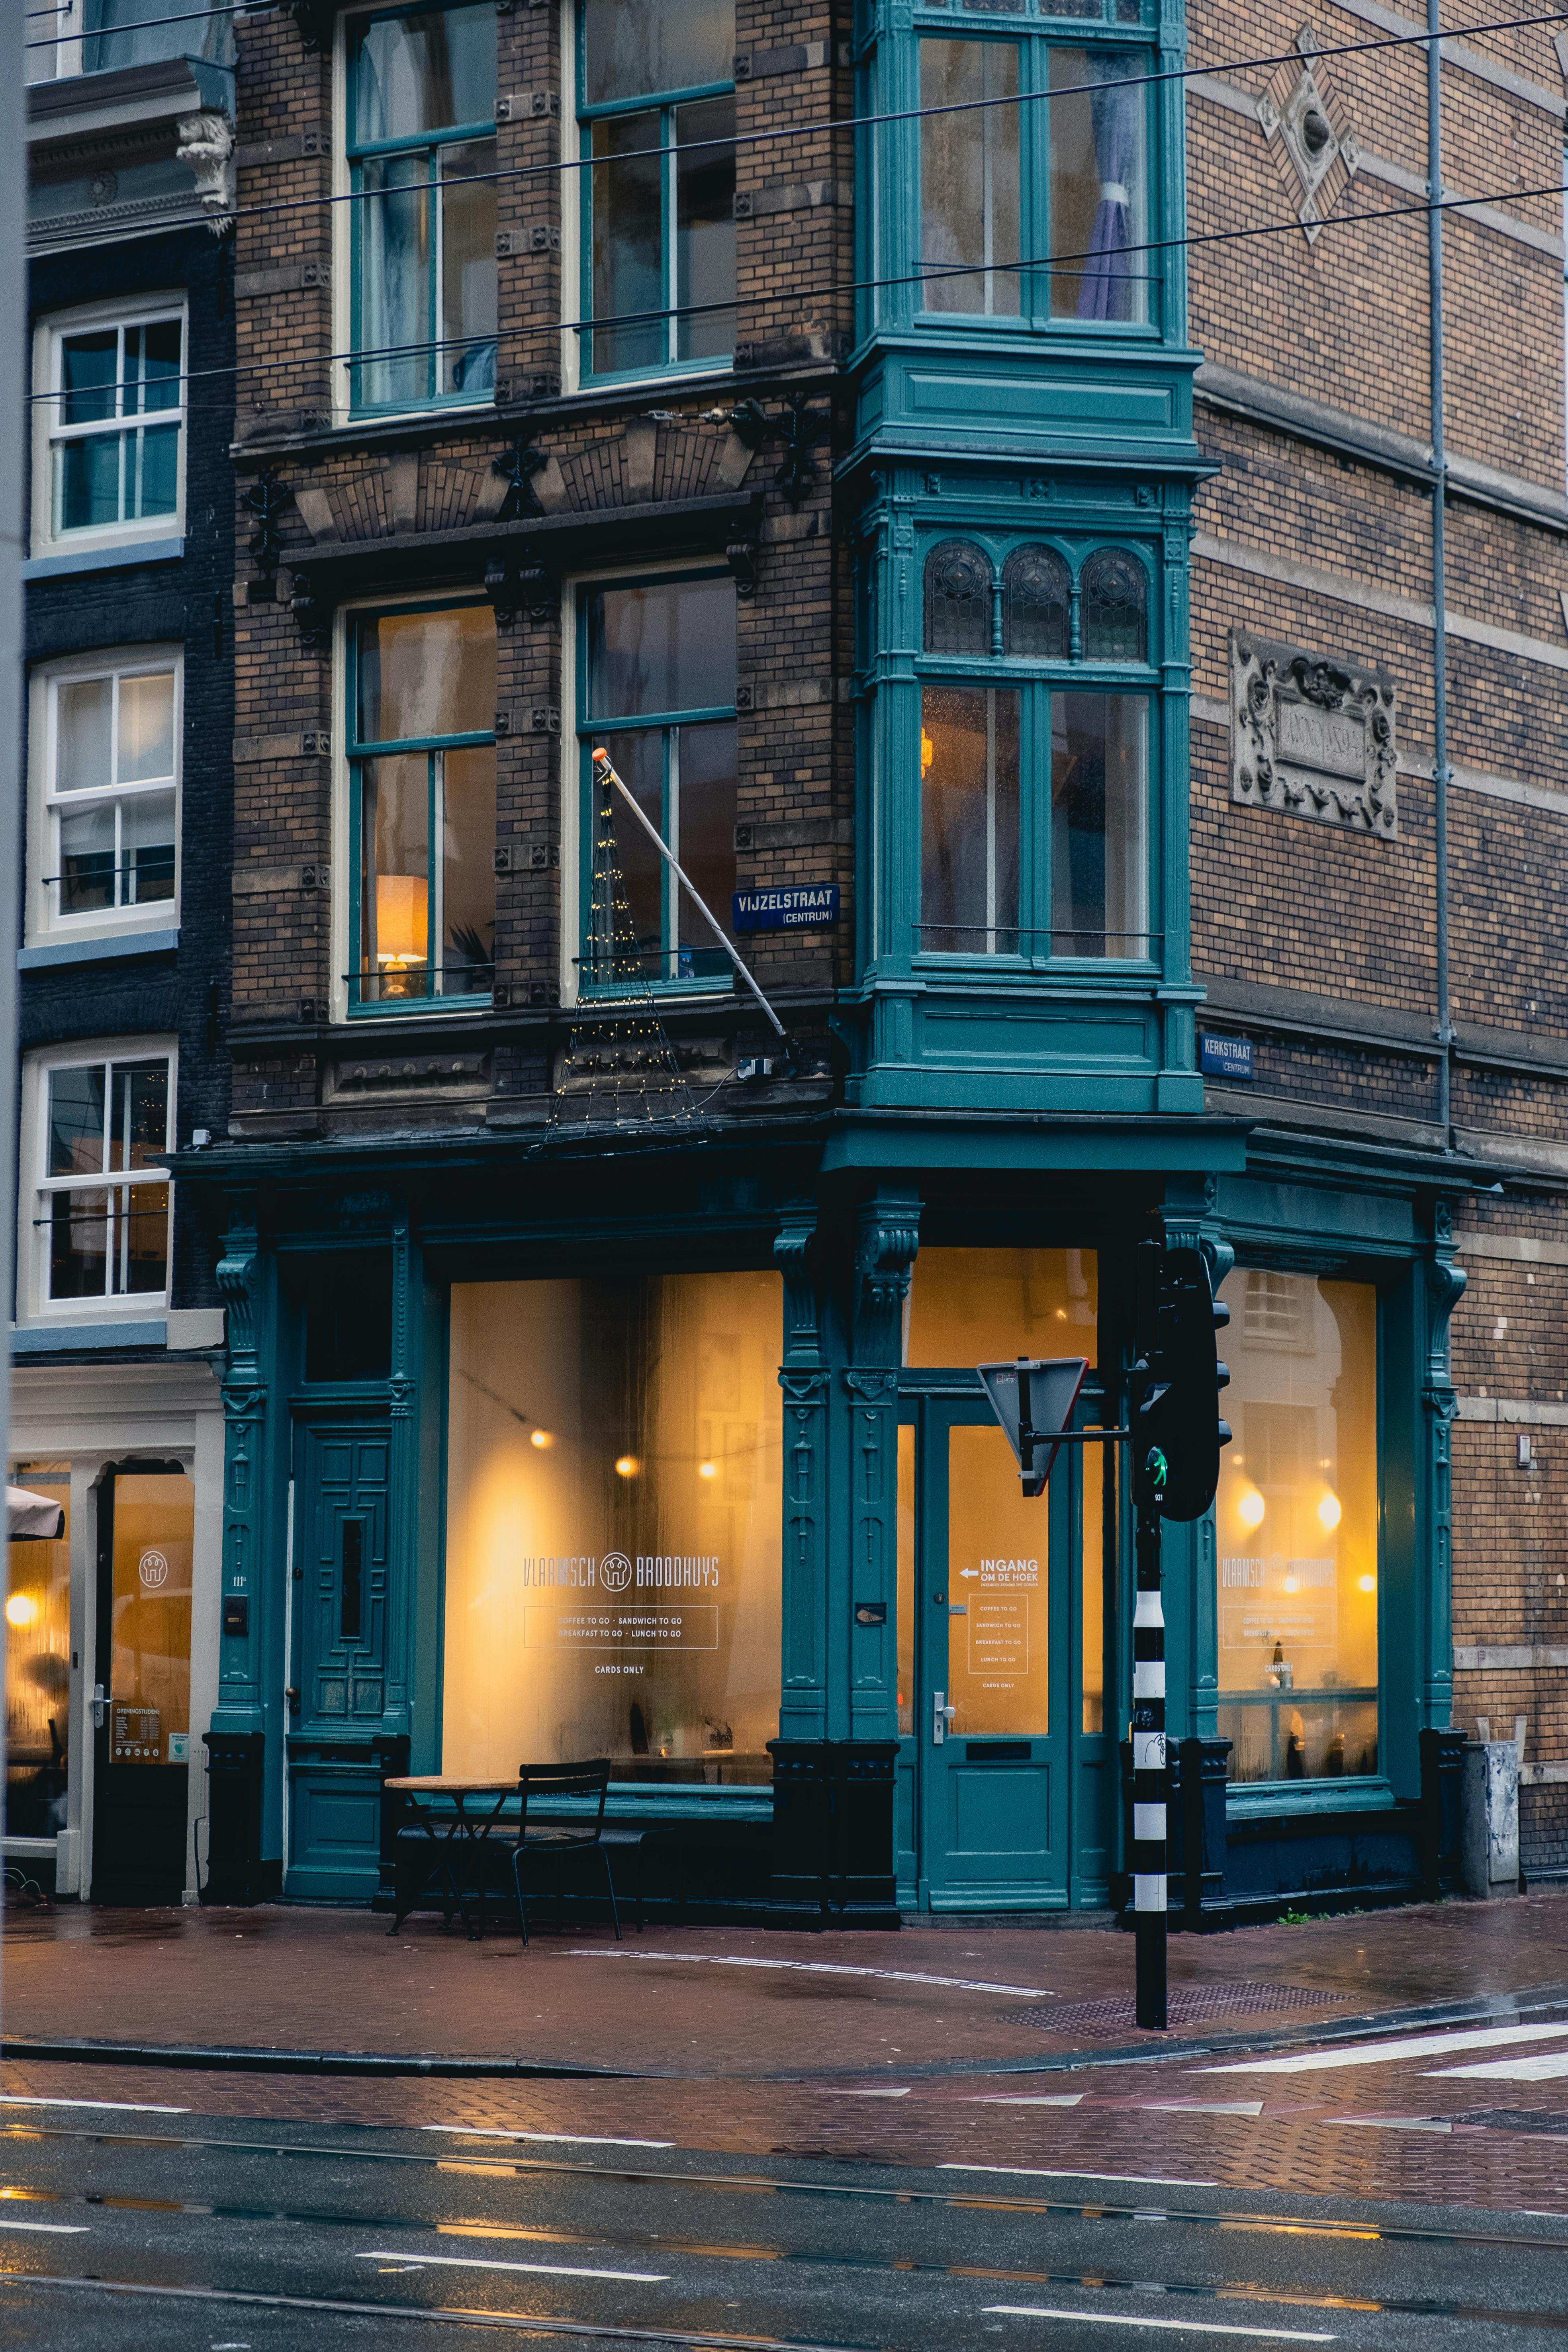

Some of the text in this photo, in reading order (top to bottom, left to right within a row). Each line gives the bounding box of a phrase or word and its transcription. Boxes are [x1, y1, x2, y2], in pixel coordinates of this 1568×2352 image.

[738, 890, 832, 912] VIJZELSTRAAT
[783, 910, 832, 924] (CENTRUM)
[1205, 1039, 1251, 1060] KERKSTRAAT
[636, 1557, 718, 1587] BROODHUYS
[981, 1560, 1038, 1571] INGANG
[1222, 1558, 1265, 1587] VLAAMSCH
[981, 1573, 1038, 1581] OM DE HOEK
